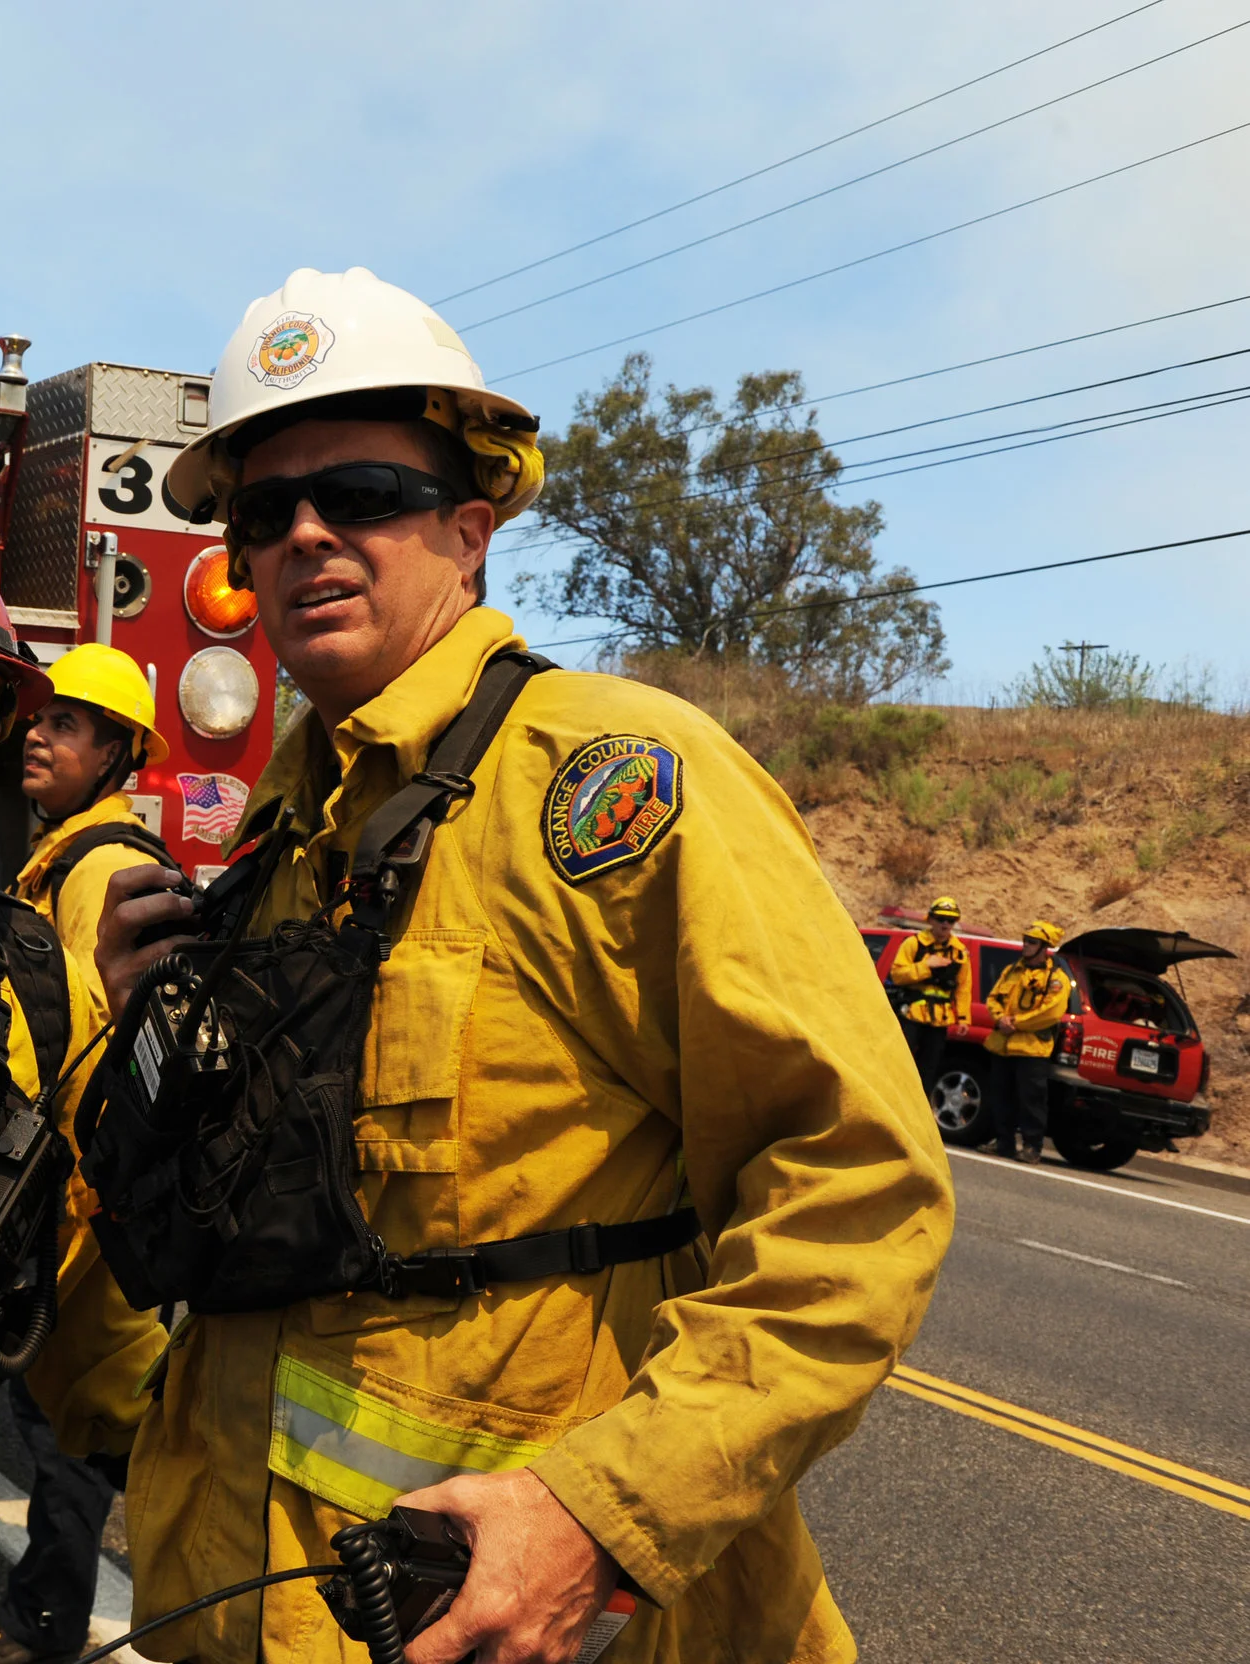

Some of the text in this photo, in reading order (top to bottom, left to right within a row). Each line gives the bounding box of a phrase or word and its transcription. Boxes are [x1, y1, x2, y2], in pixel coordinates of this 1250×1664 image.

[276, 315, 297, 326] FIRE
[261, 321, 316, 351] ORANGE COUNTY
[267, 355, 311, 375] CALIFORNIA
[268, 366, 312, 384] AUTHORITY
[216, 775, 248, 796] BLESS
[553, 740, 659, 859] ORANGE COUNTY
[624, 797, 671, 852] FIRE
[1081, 1045, 1118, 1061] FIRE
